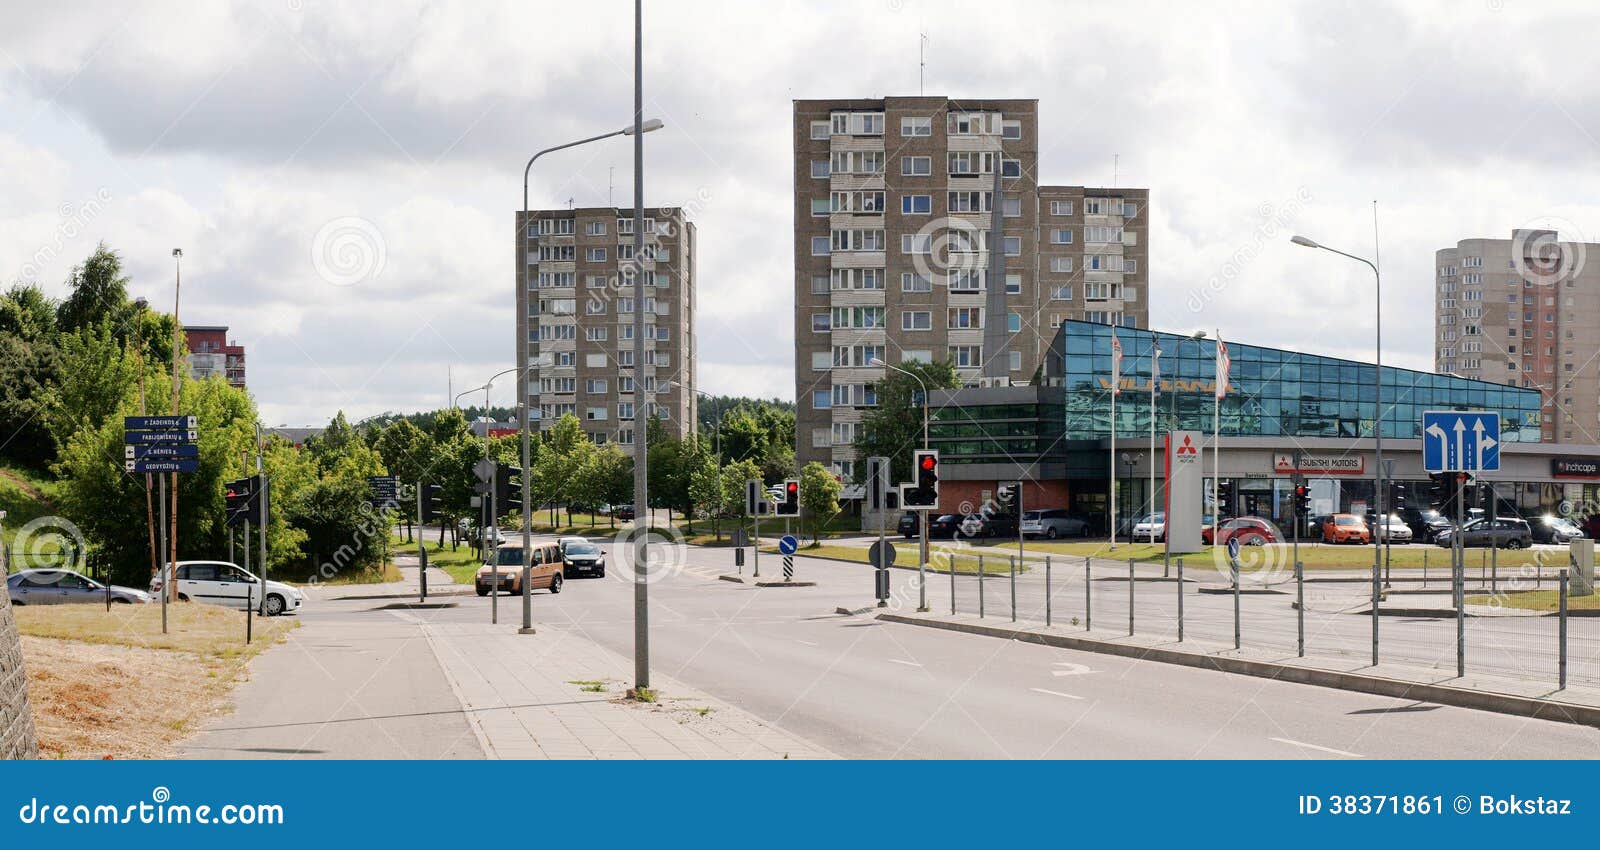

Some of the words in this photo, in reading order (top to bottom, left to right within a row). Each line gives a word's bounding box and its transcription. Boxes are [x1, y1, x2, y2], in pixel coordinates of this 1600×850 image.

[1300, 458, 1330, 467] TSUBISHI
[1331, 458, 1358, 467] MOTORS
[1565, 462, 1596, 473] Inchcape
